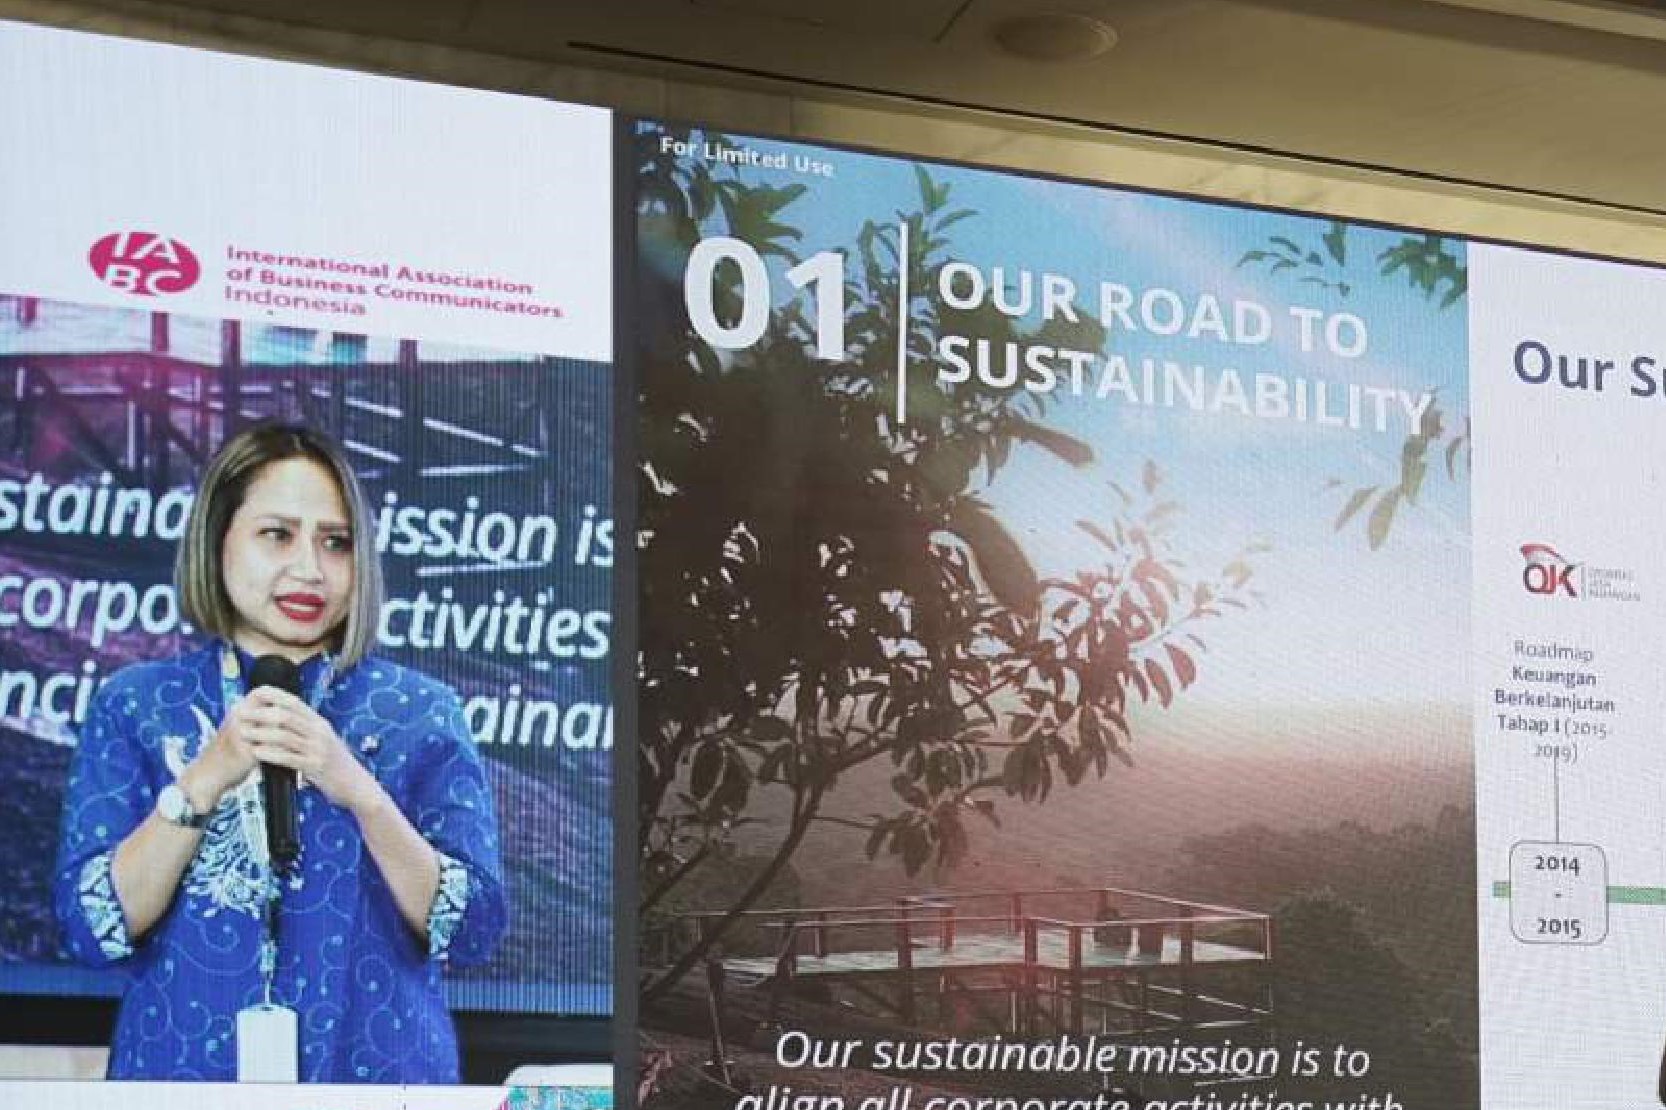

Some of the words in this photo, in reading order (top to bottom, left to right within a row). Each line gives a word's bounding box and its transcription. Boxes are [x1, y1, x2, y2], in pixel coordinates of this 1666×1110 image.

[660, 135, 698, 157] For
[705, 143, 787, 169] Limited
[795, 155, 834, 177] Use
[227, 244, 389, 279] International
[397, 266, 534, 295] Association
[225, 286, 367, 315] Indonesia
[226, 267, 253, 282] of
[259, 269, 367, 296] Business
[374, 283, 565, 318] Communicators
[685, 237, 844, 361] 01
[938, 262, 1079, 324] OUR
[1101, 282, 1272, 345] ROAD
[1289, 305, 1369, 359] TO
[938, 334, 1437, 436] SUSTAINABILITY
[1514, 340, 1615, 392] Our
[1514, 640, 1594, 664] Roadmap
[1512, 666, 1597, 688] Keuangan
[1495, 688, 1615, 713] Berkelanjutan
[1498, 715, 1549, 736] Tahap
[1535, 855, 1580, 877] 2014
[1537, 918, 1582, 939] 2015
[776, 1031, 863, 1069] Our
[872, 1035, 1116, 1074] sustainable
[1128, 1038, 1281, 1076] mission
[1291, 1041, 1321, 1077] is
[1334, 1045, 1371, 1078] to
